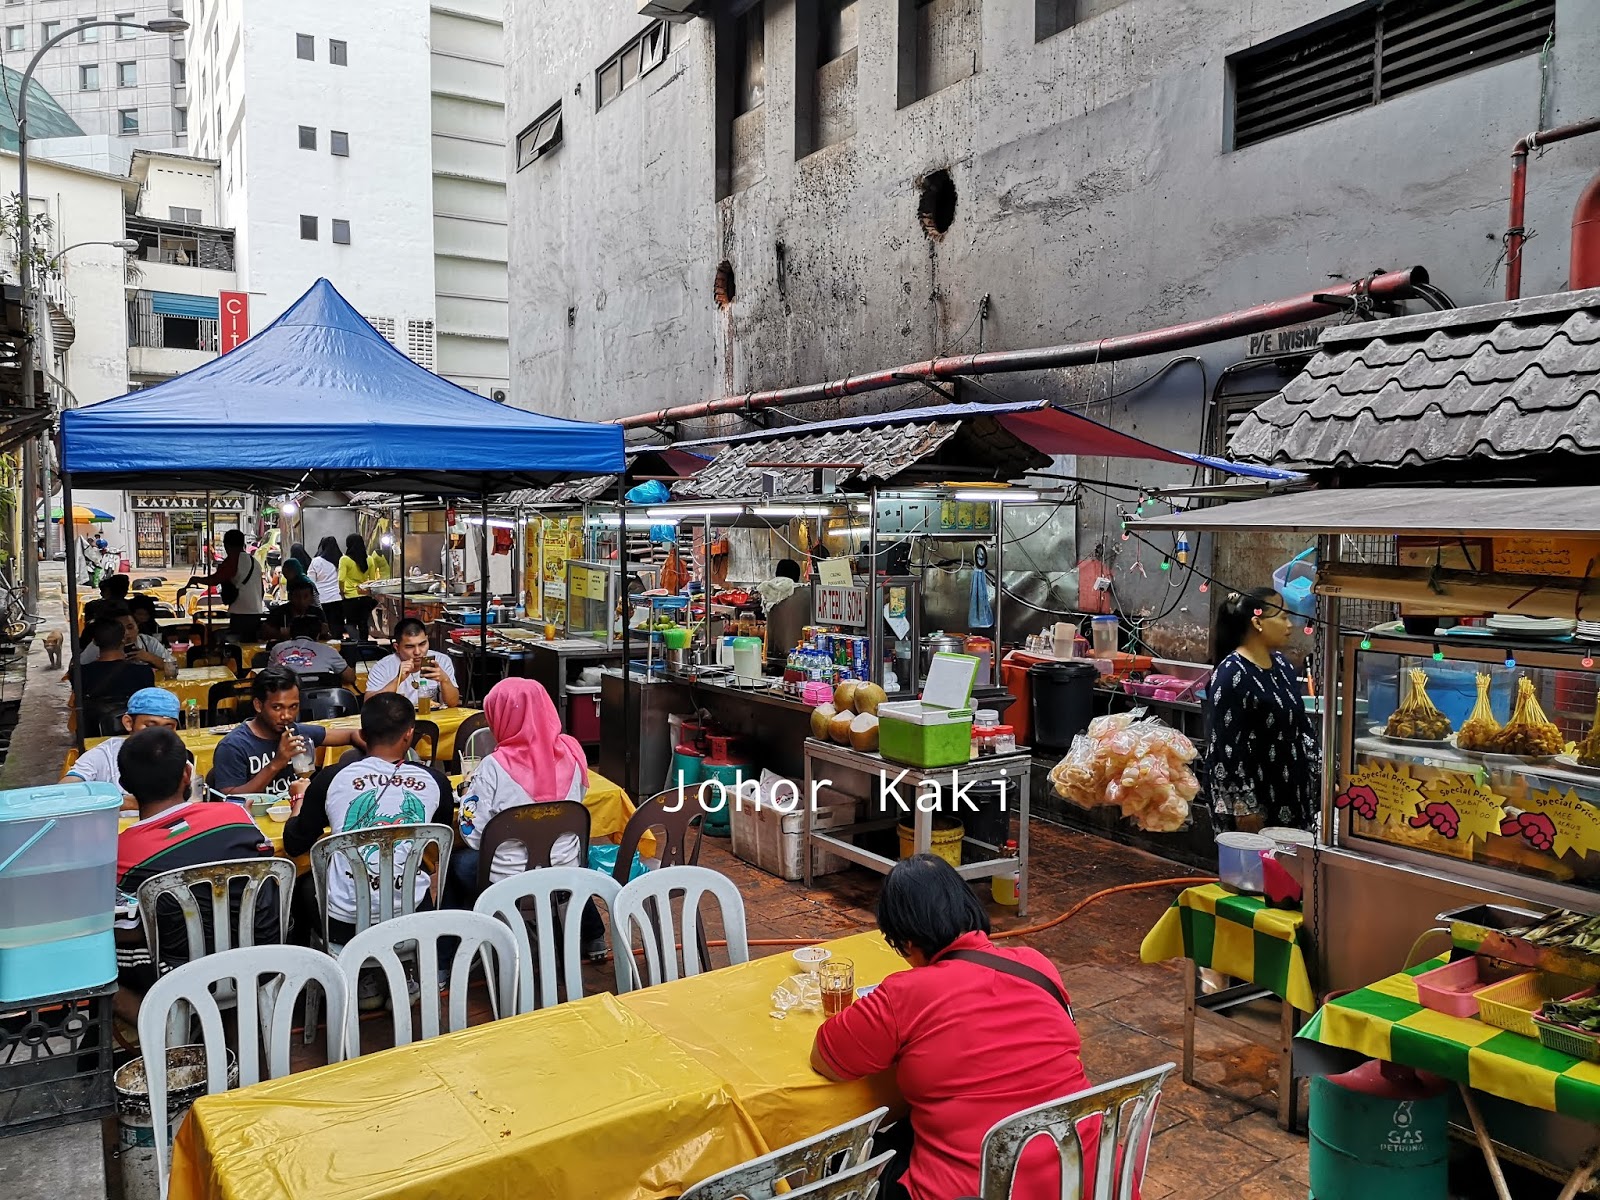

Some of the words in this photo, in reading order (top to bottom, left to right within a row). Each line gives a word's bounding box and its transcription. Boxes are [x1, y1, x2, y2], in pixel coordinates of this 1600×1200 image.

[1249, 333, 1272, 354] P/E
[137, 498, 198, 508] KATARI
[847, 591, 863, 622] SOYA
[1361, 770, 1389, 780] Special
[1440, 786, 1471, 797] Special
[1456, 799, 1482, 808] BABAT
[1536, 798, 1573, 809] Special
[1553, 811, 1572, 820] MEE
[1387, 1130, 1423, 1144] GAS
[1380, 1143, 1428, 1153] PETRONA
